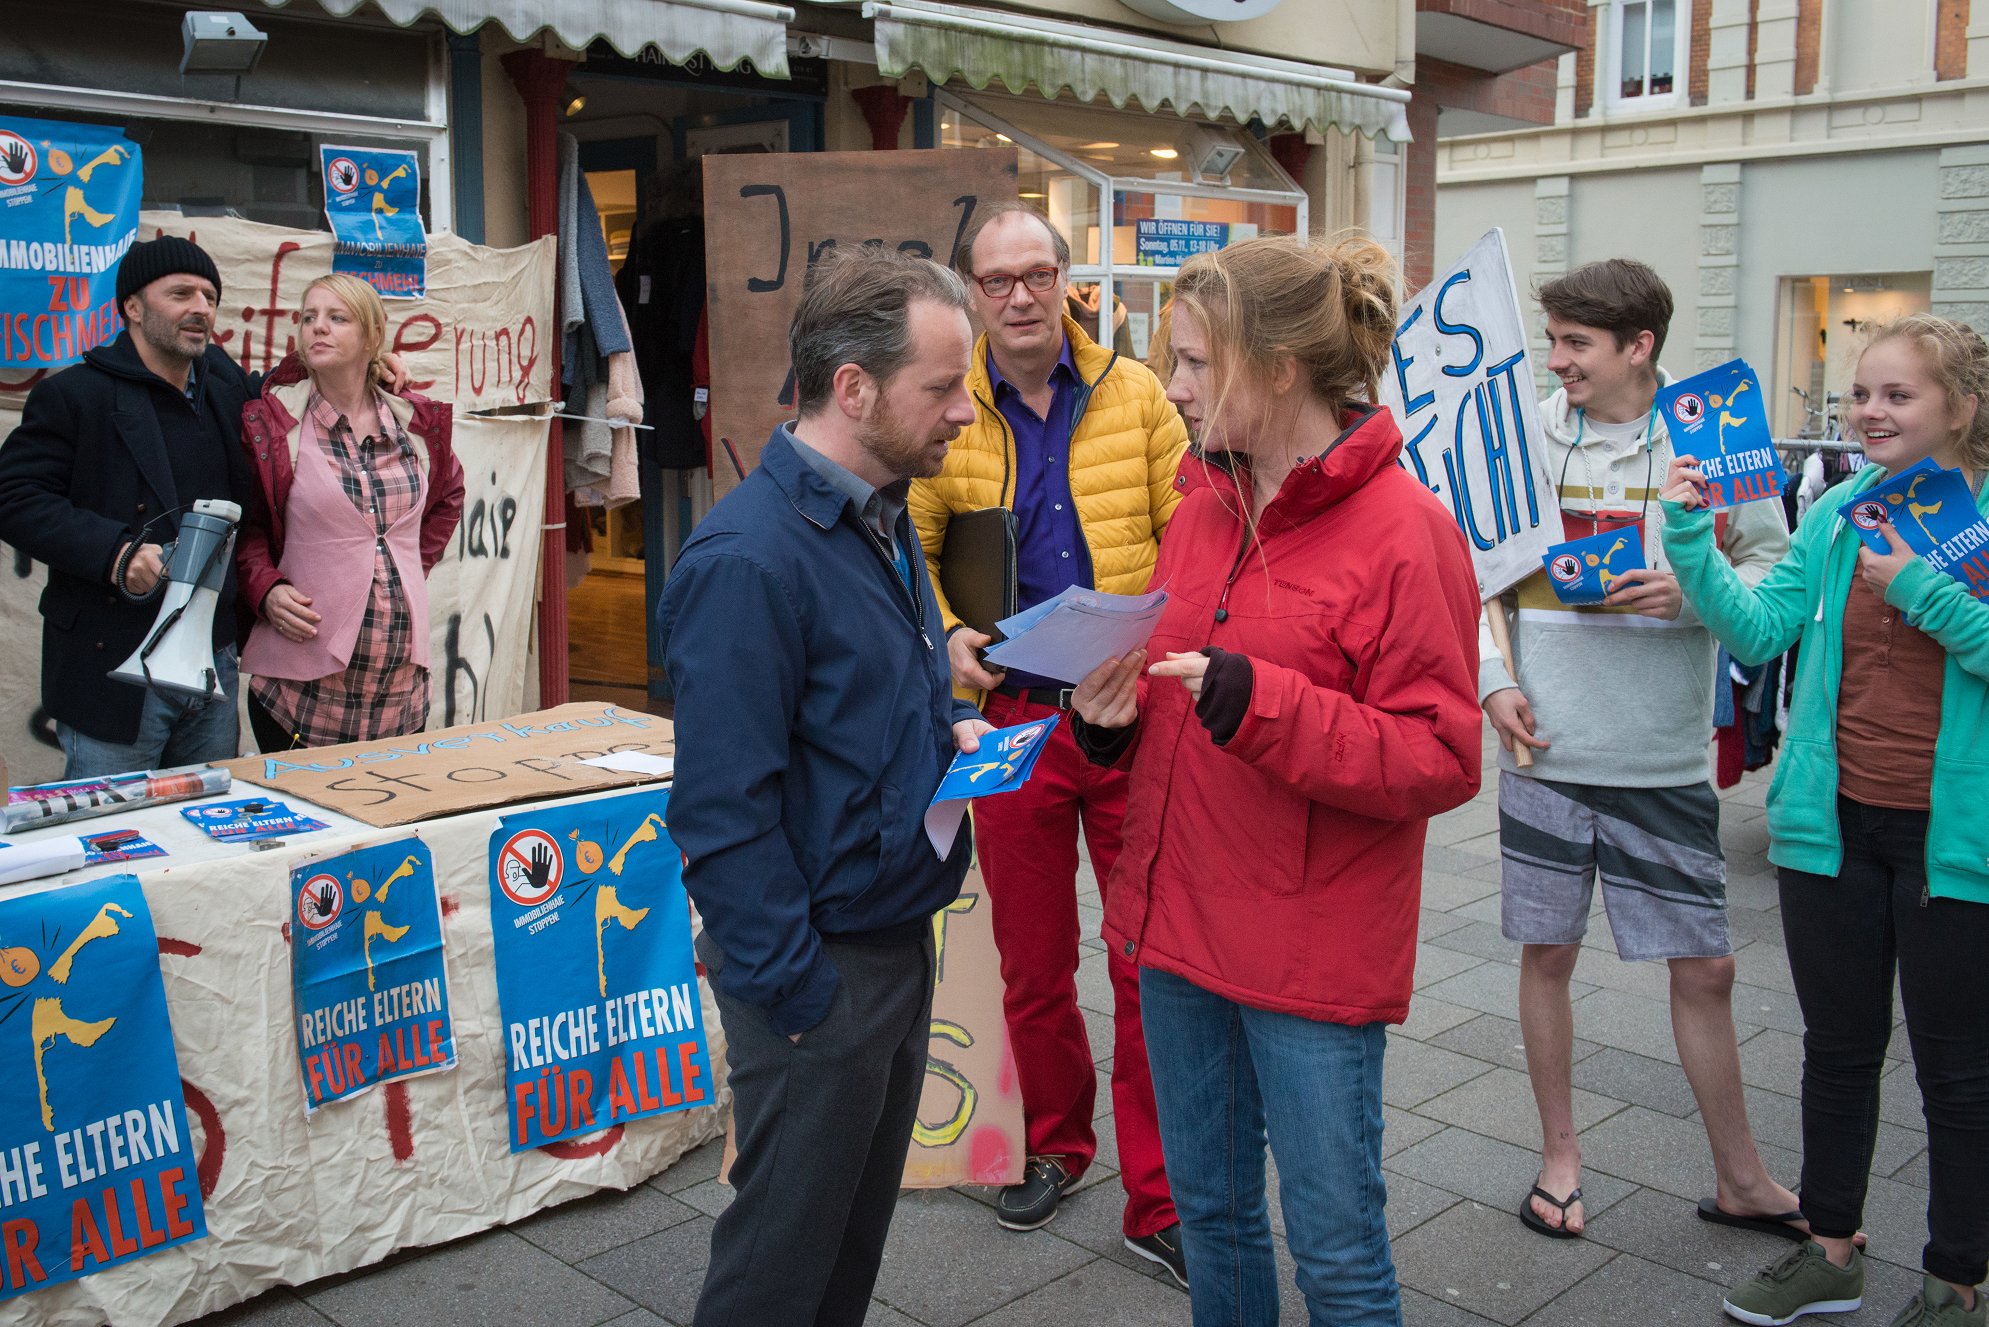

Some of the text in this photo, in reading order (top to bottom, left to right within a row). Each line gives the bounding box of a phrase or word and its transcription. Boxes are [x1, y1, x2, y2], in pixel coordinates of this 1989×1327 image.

[1140, 220, 1220, 237] WIR ÖFFNEN FÜR SIE!
[48, 275, 91, 312] ZU
[1392, 268, 1484, 418] ES
[1725, 447, 1774, 475] ELTERN
[1733, 471, 1781, 503] ALLE
[209, 822, 250, 832] REICHE
[253, 817, 293, 828] ELTERN
[513, 894, 565, 929] IMMOBILIENHAIE
[528, 911, 560, 935] STOPPEN!
[302, 977, 442, 1050] REICHE ELTERN
[510, 983, 695, 1072] REICHE ELTERN
[305, 1019, 447, 1102] FÜR ALLE
[514, 1041, 705, 1146] FÜR ALLE
[54, 1099, 181, 1190] ELTERN
[70, 1166, 195, 1273] ALLE
